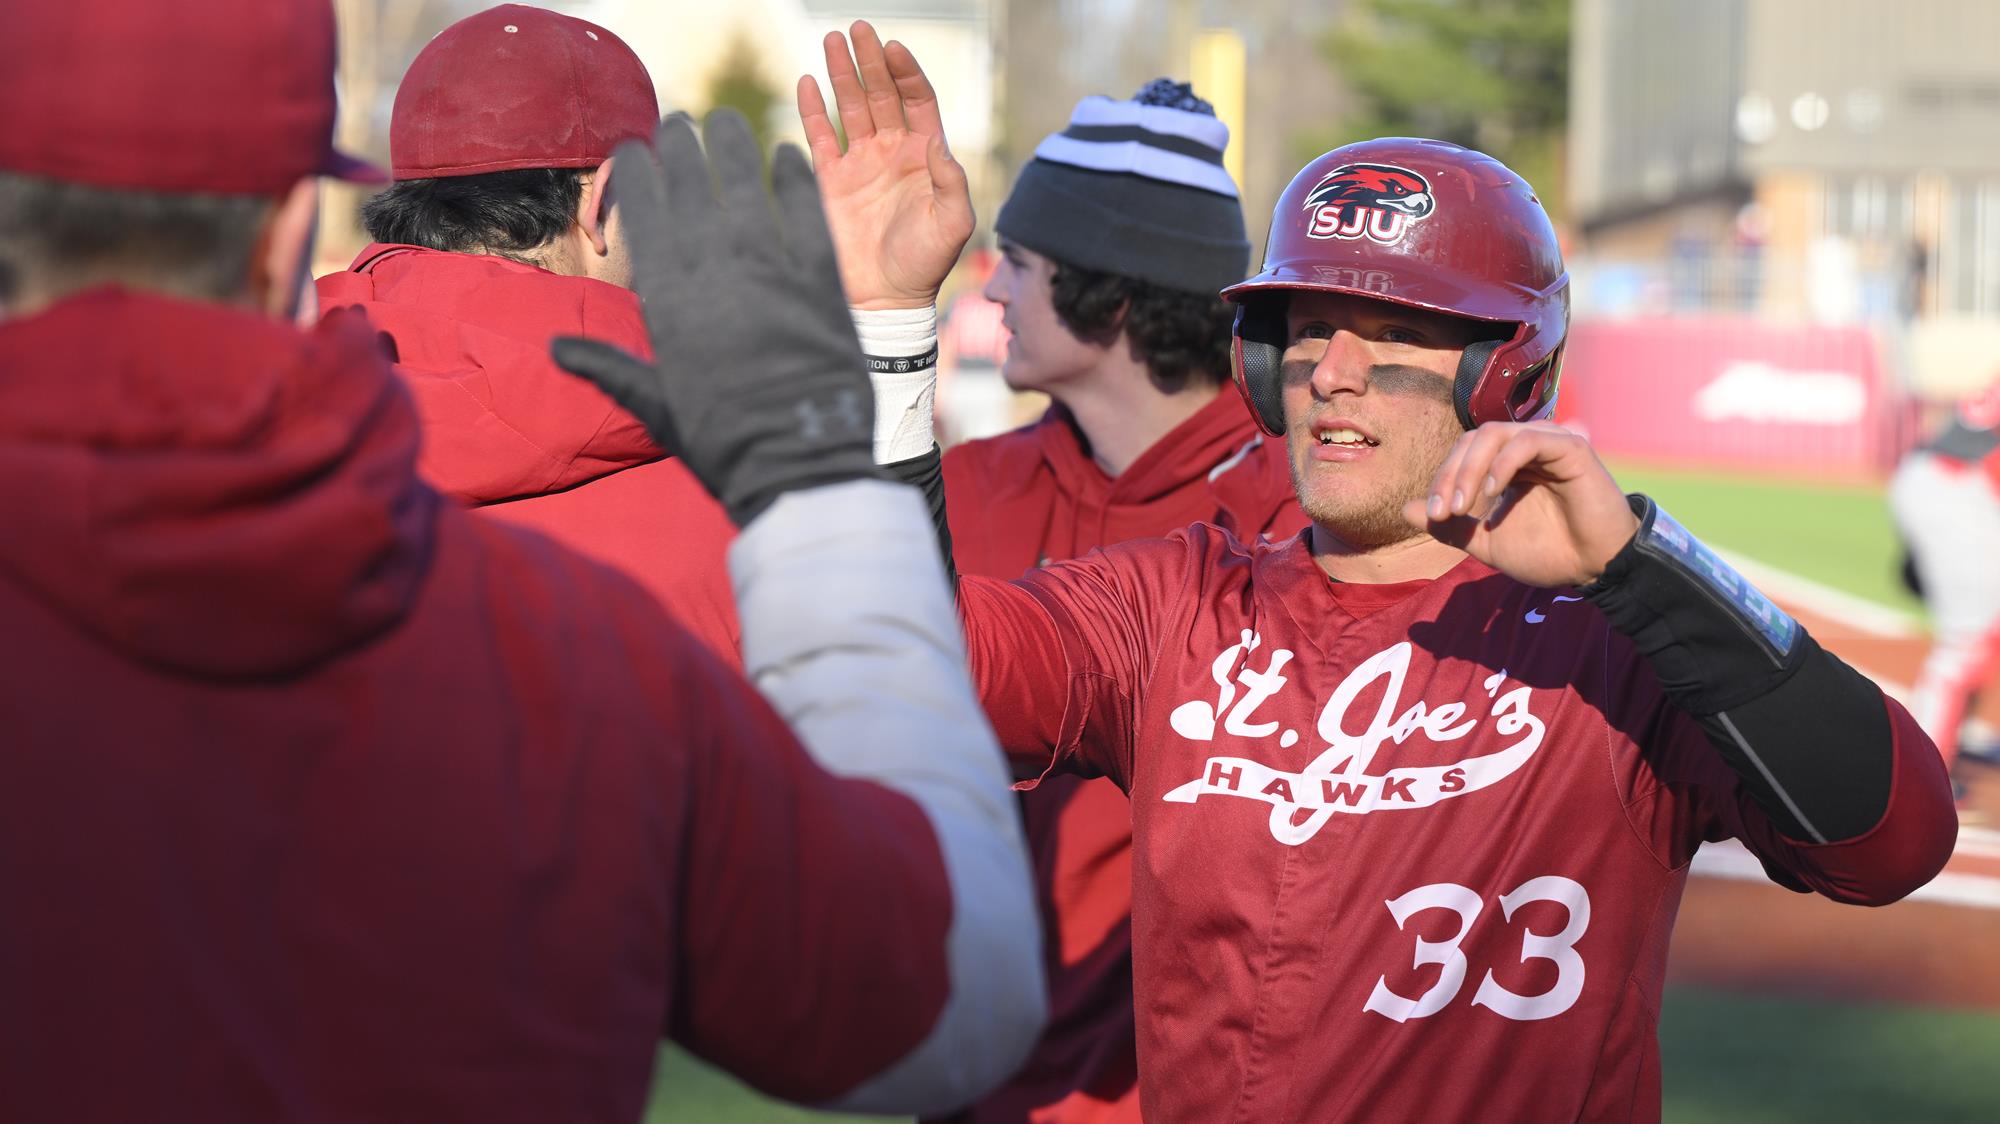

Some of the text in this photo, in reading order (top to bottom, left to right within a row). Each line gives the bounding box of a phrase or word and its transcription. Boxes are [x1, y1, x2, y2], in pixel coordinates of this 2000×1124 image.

[1311, 205, 1409, 241] SJU
[1170, 628, 1546, 846] St. Joe's
[1207, 761, 1467, 807] HAWKS
[1362, 875, 1591, 1023] 33
